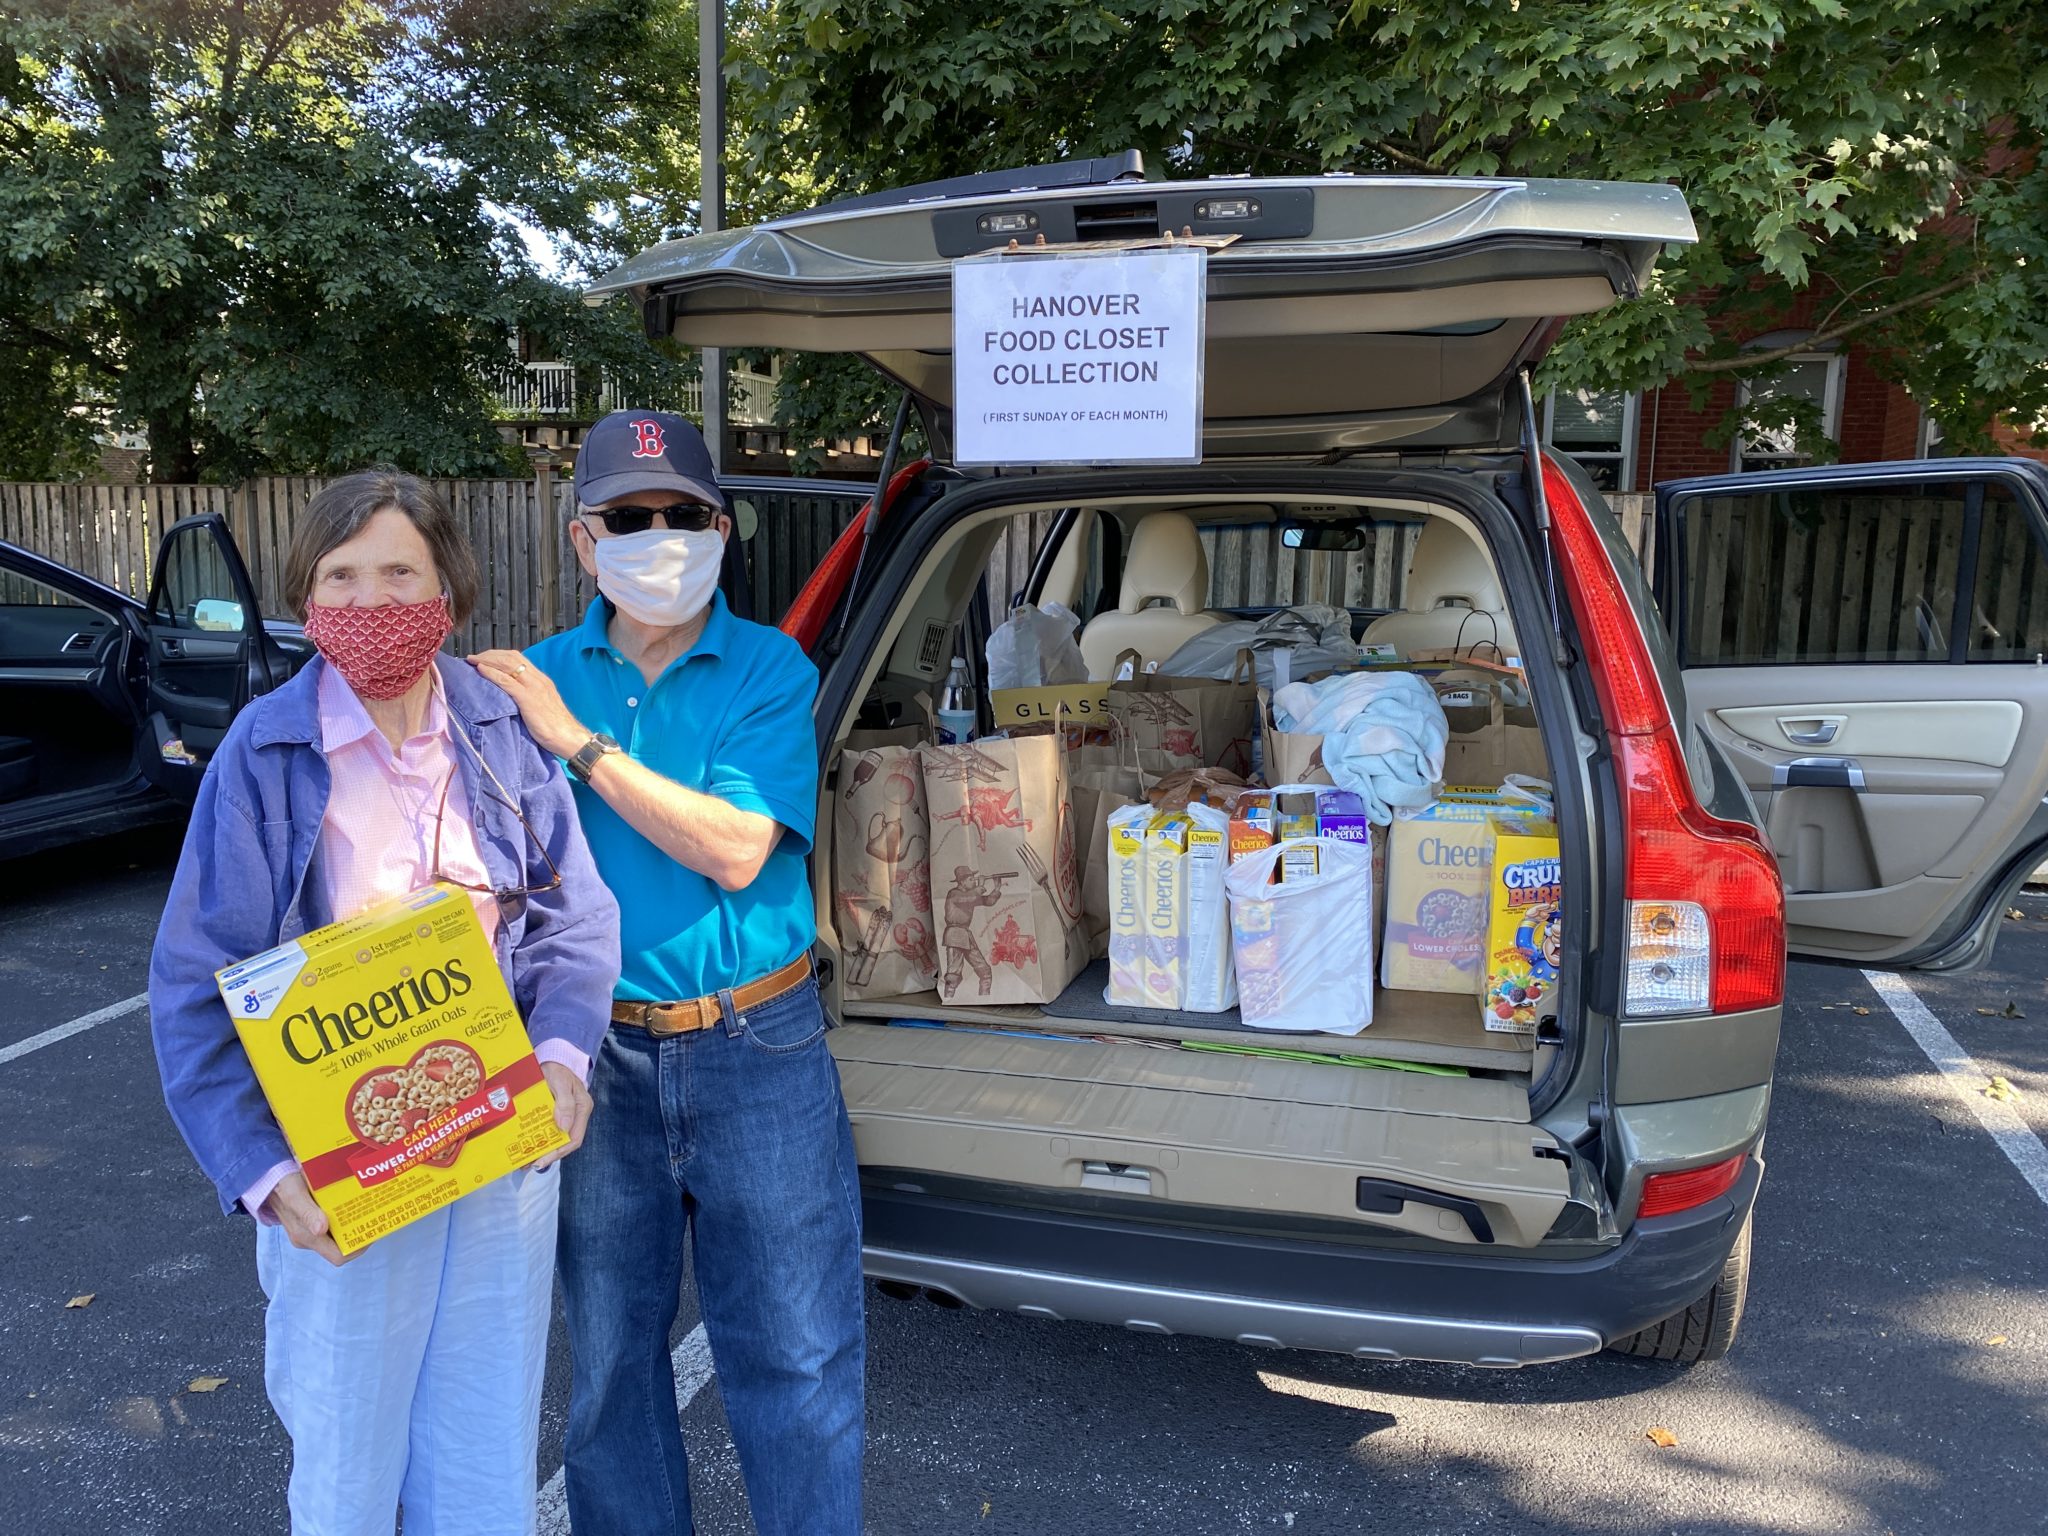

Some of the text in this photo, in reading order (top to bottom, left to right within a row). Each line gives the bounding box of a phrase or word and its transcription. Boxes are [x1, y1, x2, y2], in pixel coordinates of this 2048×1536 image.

[1012, 293, 1141, 319] HANOVER
[984, 327, 1170, 353] FOOD CLOSET
[993, 361, 1158, 386] COLLECTION
[1023, 411, 1068, 422] SUNDAY
[1070, 411, 1086, 421] OF
[1089, 410, 1120, 421] EACH
[1123, 409, 1168, 421] MONTH)
[629, 419, 668, 458] B
[1016, 699, 1109, 718] GLASS
[1192, 834, 1220, 842] Cheerios
[1232, 839, 1268, 850] Cheerios
[1322, 828, 1363, 840] Cheerios
[1116, 858, 1137, 928] Cheerios
[1152, 859, 1173, 929] Cheerios
[1508, 885, 1561, 907] BERR
[370, 941, 384, 954] 1st
[1414, 943, 1481, 952] LOWER CHOLES
[257, 984, 279, 998] General
[280, 958, 472, 1065] Cheerios
[463, 1016, 495, 1037] Gluten
[493, 1007, 514, 1023] Free
[339, 1003, 467, 1069] 100% Whole Grain Oats
[402, 1107, 459, 1147] CAN HELP
[356, 1152, 407, 1180] LOWER
[405, 1103, 489, 1158] CHOLESTEROL
[393, 1165, 402, 1174] AS
[401, 1157, 417, 1170] PART
[416, 1152, 425, 1162] OF
[430, 1138, 449, 1153] HEART
[448, 1124, 472, 1142] HEALTHY
[470, 1117, 483, 1129] DIET
[356, 1224, 366, 1233] LB
[377, 1213, 387, 1222] OZ
[430, 1178, 458, 1195] CARTONS
[346, 1234, 365, 1248] TOTAL
[364, 1228, 377, 1239] NET
[392, 1216, 401, 1225] LB
[409, 1207, 418, 1216] OZ
